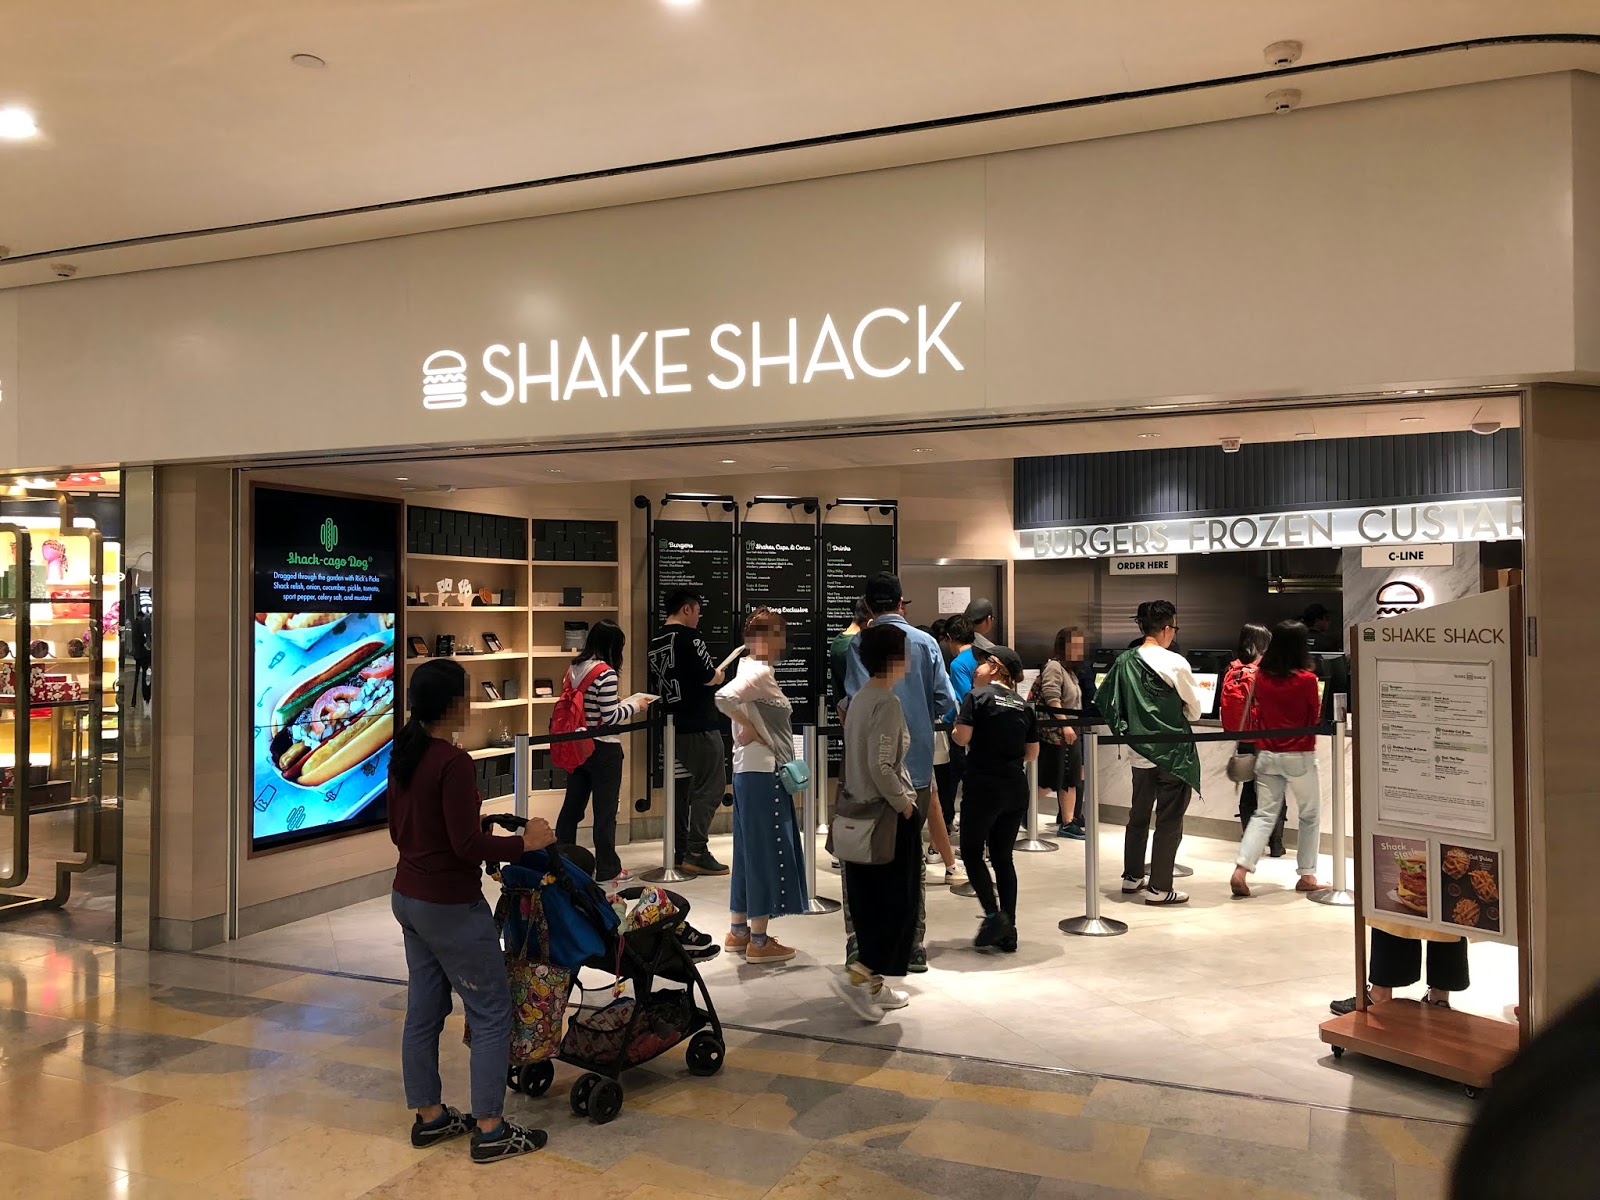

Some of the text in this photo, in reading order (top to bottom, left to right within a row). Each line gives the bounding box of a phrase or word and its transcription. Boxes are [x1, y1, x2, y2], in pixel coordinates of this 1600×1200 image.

[480, 301, 965, 407] SHAKE SHACK
[1033, 523, 1169, 558] BURGERS
[1189, 512, 1333, 549] FROZEN
[668, 541, 694, 550] Burgers
[790, 543, 796, 551] &
[796, 543, 811, 551] Cones
[832, 544, 851, 552] Drinks
[287, 552, 347, 570] Shack-cago
[1388, 551, 1424, 561] C-LINE
[1117, 561, 1168, 570] ORDER HERE
[274, 572, 297, 581] Dragged
[298, 572, 317, 582] through
[327, 574, 344, 582] garden
[273, 582, 289, 590] Shack
[290, 582, 305, 591] relish,
[322, 584, 346, 592] cucumber,
[283, 594, 296, 602] sport
[297, 594, 317, 602] pepper,
[317, 593, 333, 602] celery
[1382, 627, 1505, 644] SHAKE SHACK
[1381, 842, 1407, 850] Shack
